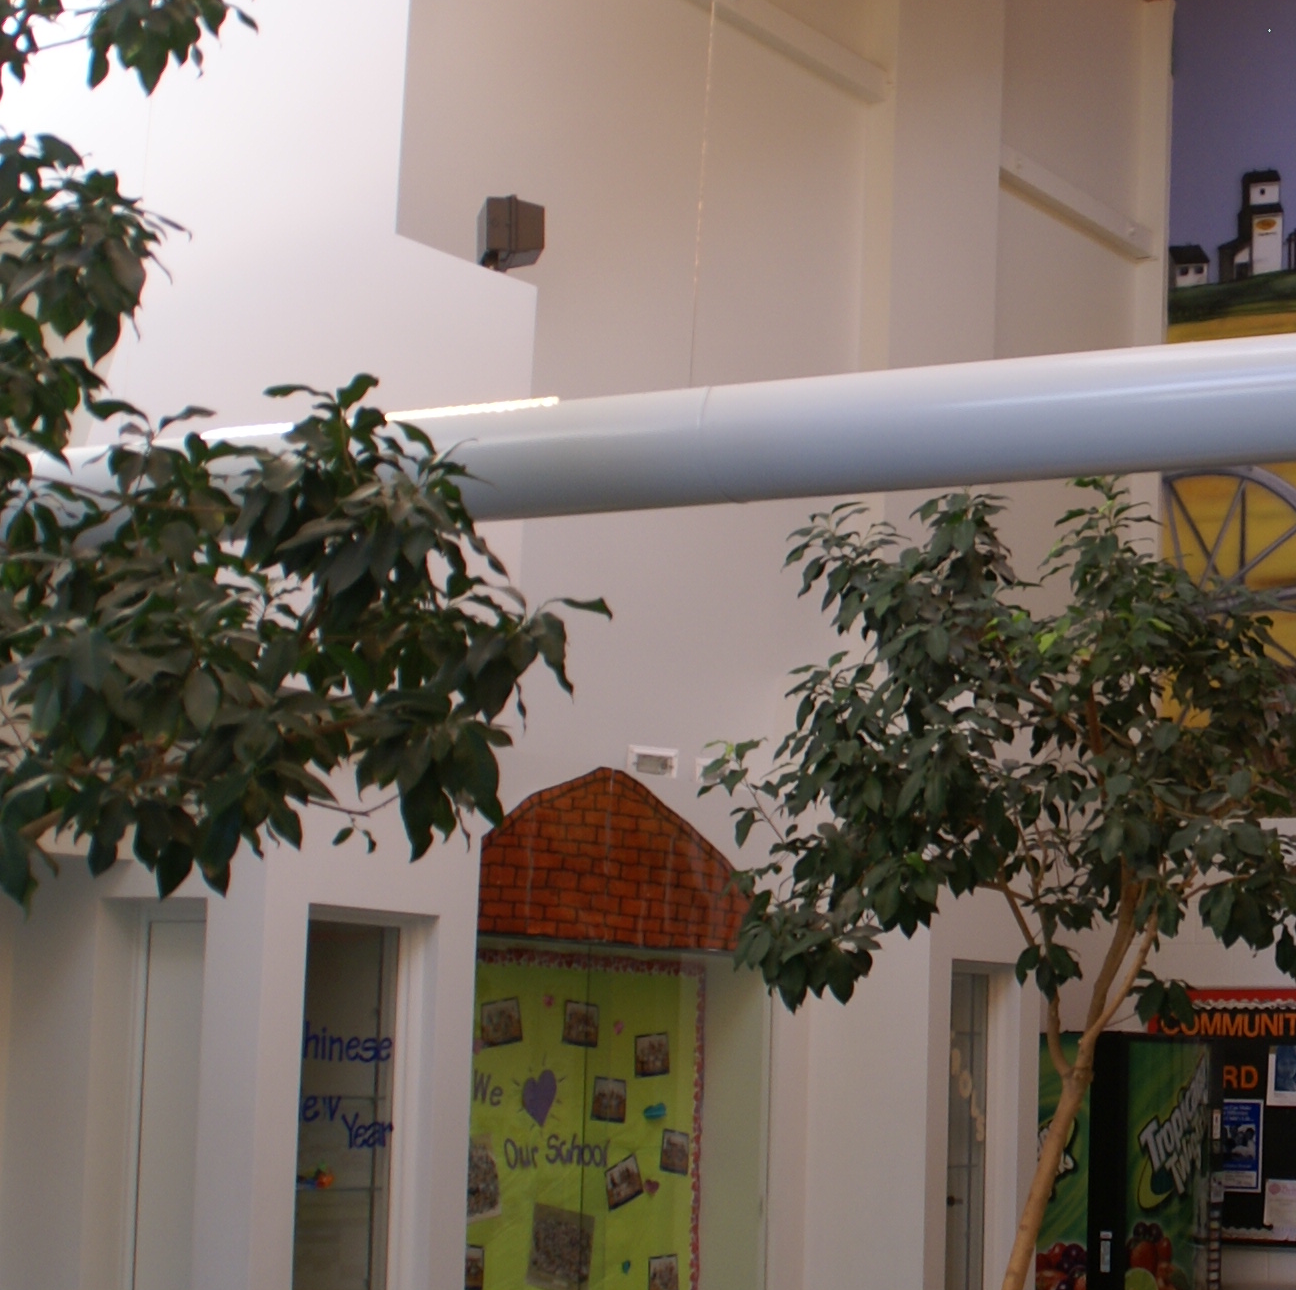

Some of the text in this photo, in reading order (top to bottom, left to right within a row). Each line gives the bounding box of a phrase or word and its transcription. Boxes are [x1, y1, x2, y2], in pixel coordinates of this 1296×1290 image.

[304, 1021, 393, 1062] hinese
[473, 1069, 503, 1106] We
[341, 1113, 393, 1149] Year
[1139, 1051, 1208, 1175] Tropica
[503, 1132, 610, 1170] Our School
